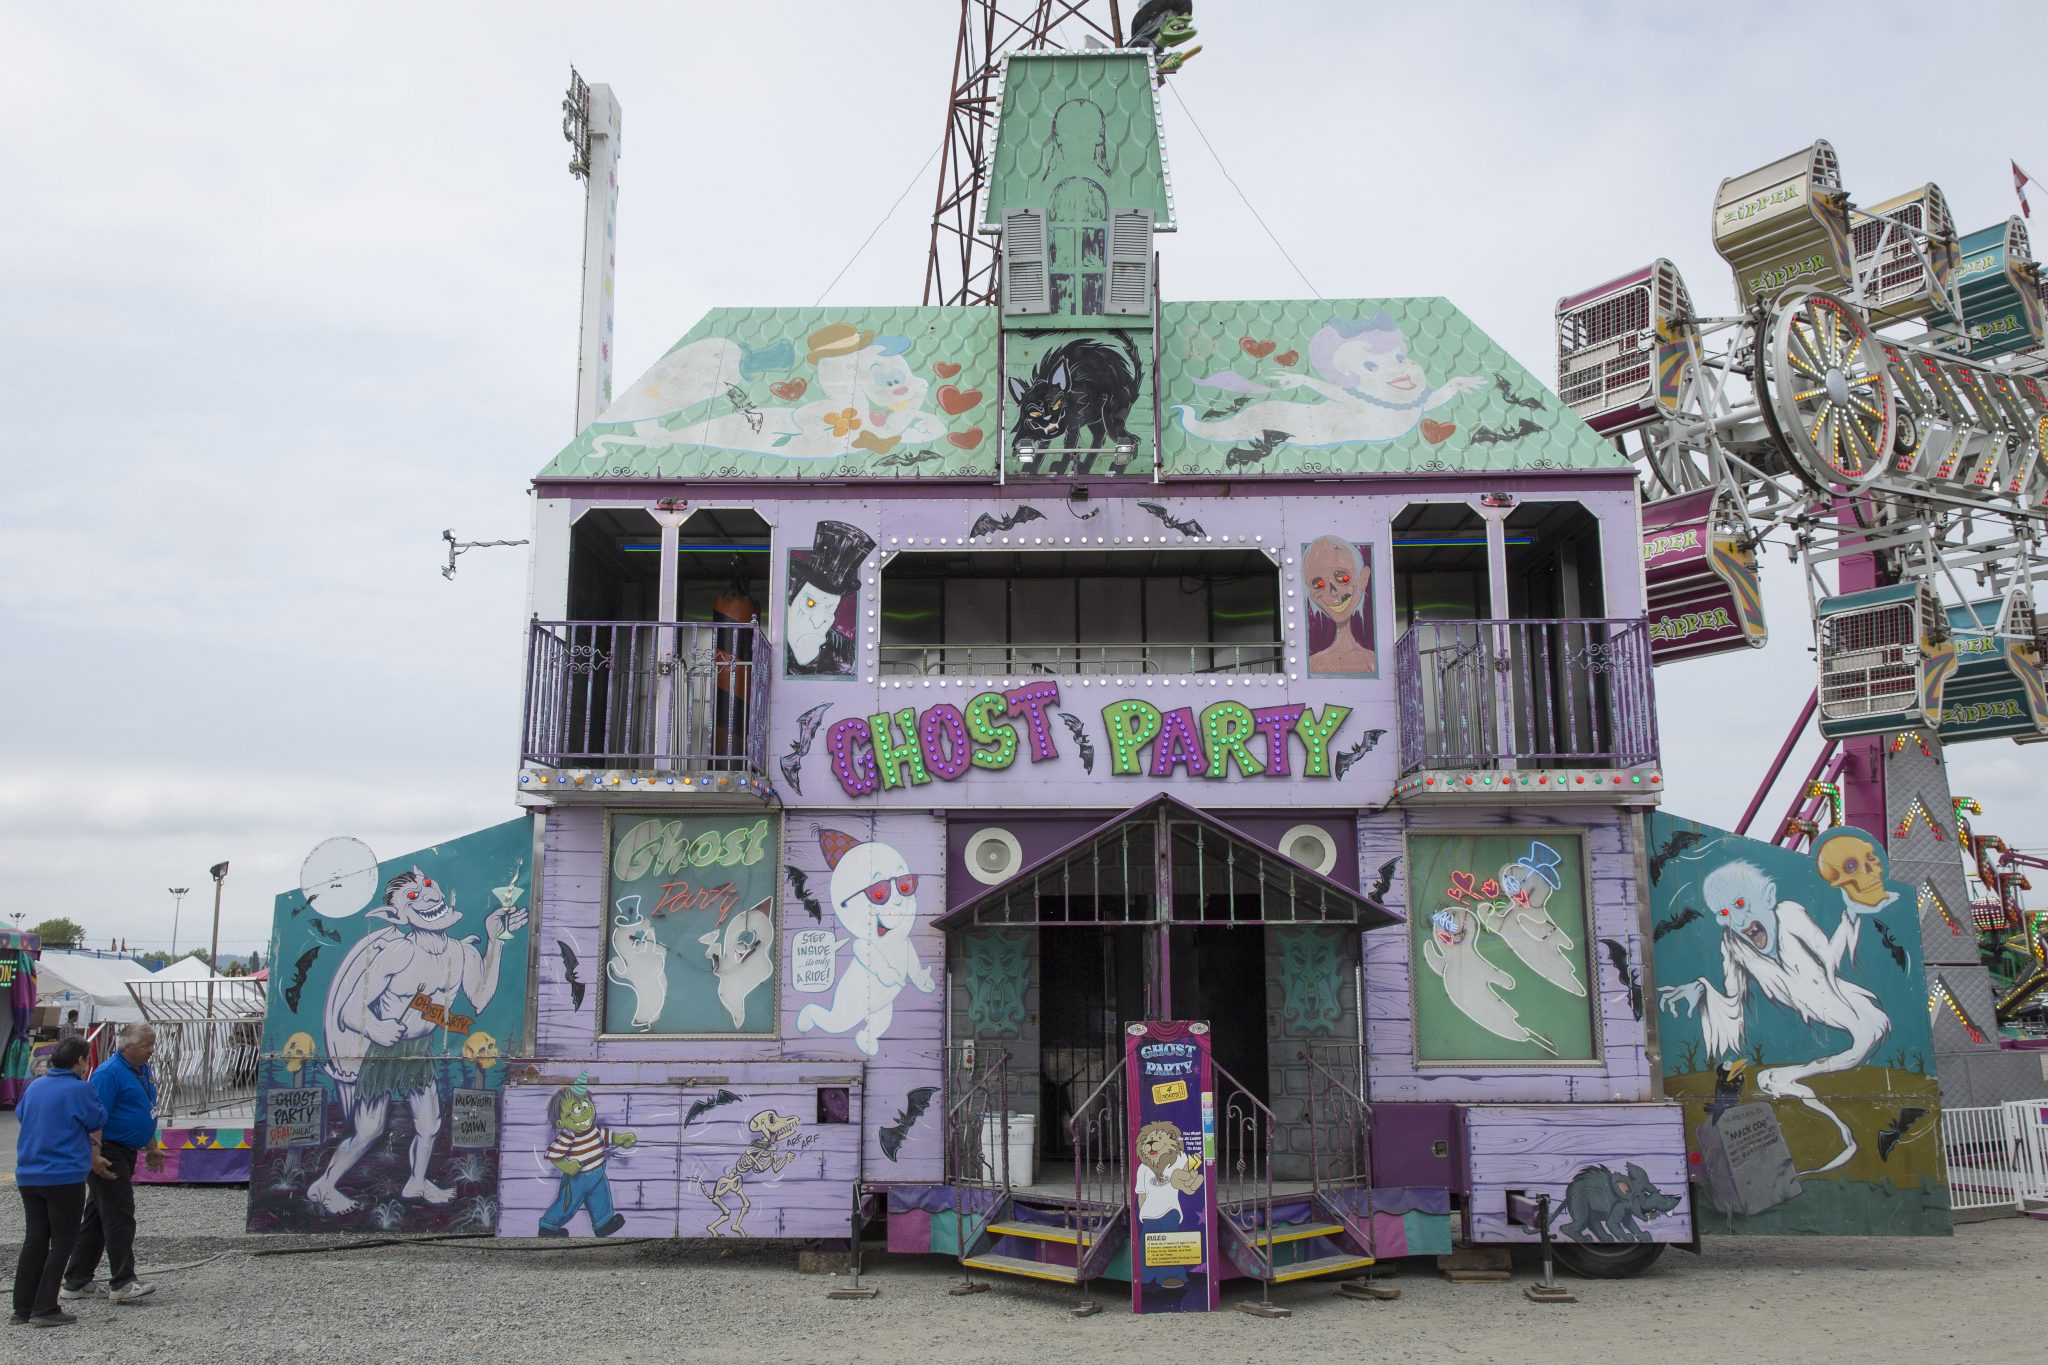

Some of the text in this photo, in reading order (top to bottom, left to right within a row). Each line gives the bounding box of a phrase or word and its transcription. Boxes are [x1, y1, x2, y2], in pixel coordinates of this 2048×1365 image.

[826, 680, 1354, 798] GHOST PARTY
[614, 819, 768, 882] Ghost
[652, 881, 741, 927] Party
[801, 932, 826, 945] STEP
[797, 945, 831, 956] INSIDE
[797, 967, 831, 985] A RIDE!
[1140, 1043, 1197, 1059] GHOST
[1145, 1060, 1193, 1076] PARTY
[1166, 1085, 1172, 1094] 4
[275, 1090, 319, 1108] GHOST
[274, 1105, 315, 1125] PARTY
[461, 1119, 487, 1135] DAWN
[786, 1133, 821, 1150] ARF ARF
